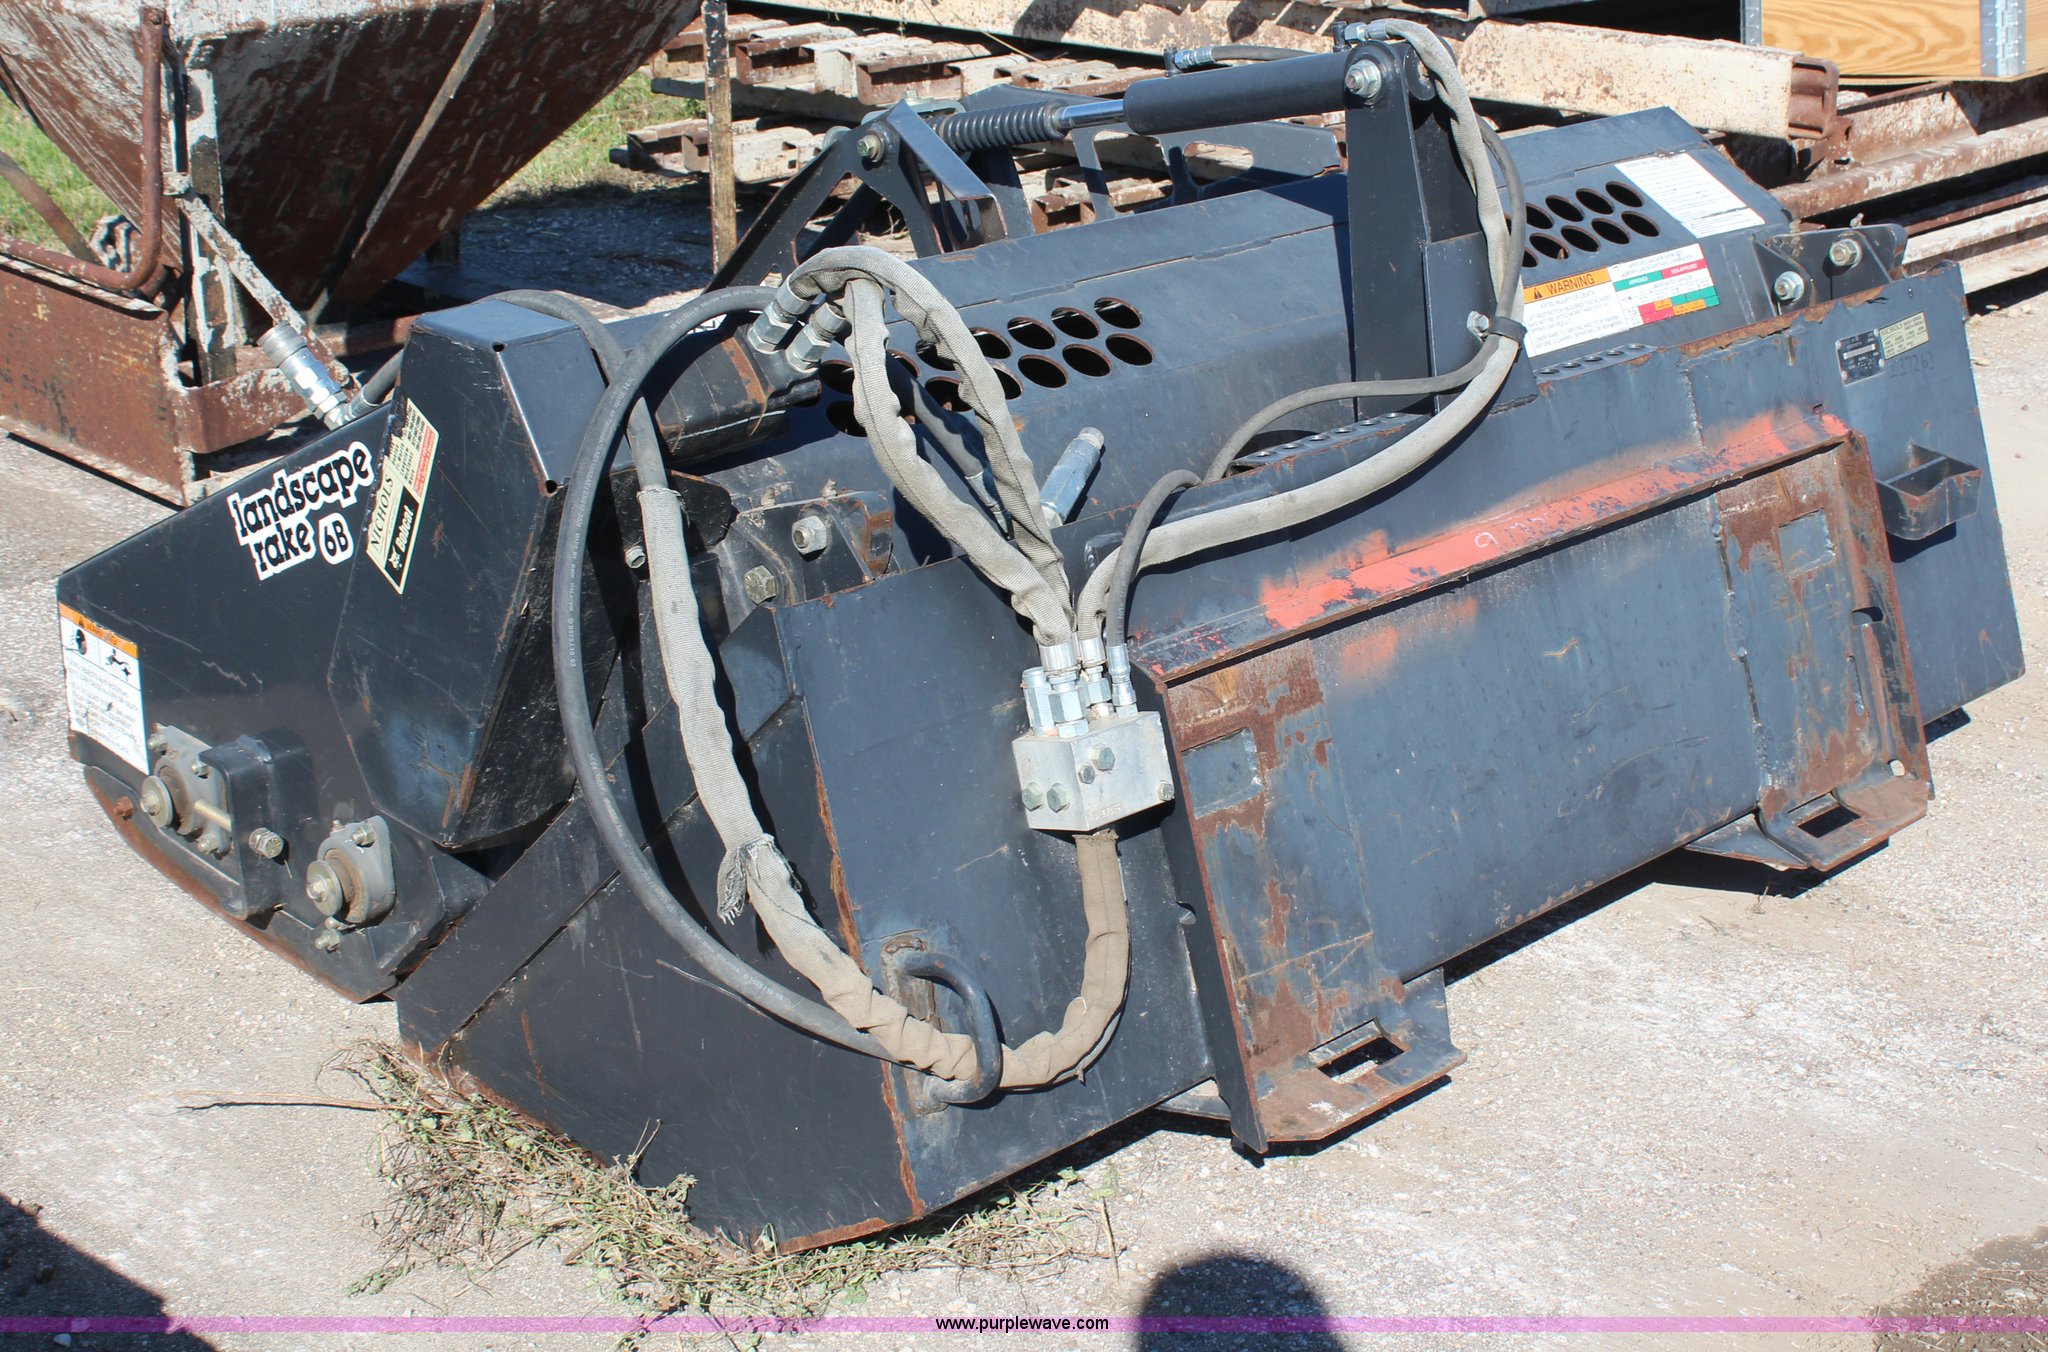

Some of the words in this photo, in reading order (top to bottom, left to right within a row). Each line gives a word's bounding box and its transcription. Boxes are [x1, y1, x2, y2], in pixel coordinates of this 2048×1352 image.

[1547, 273, 1595, 295] WARNING
[233, 448, 370, 538] landscape
[369, 475, 394, 552] NICHOLS
[253, 521, 311, 572] rake
[323, 519, 349, 557] 6B
[395, 504, 415, 553] Bobcat
